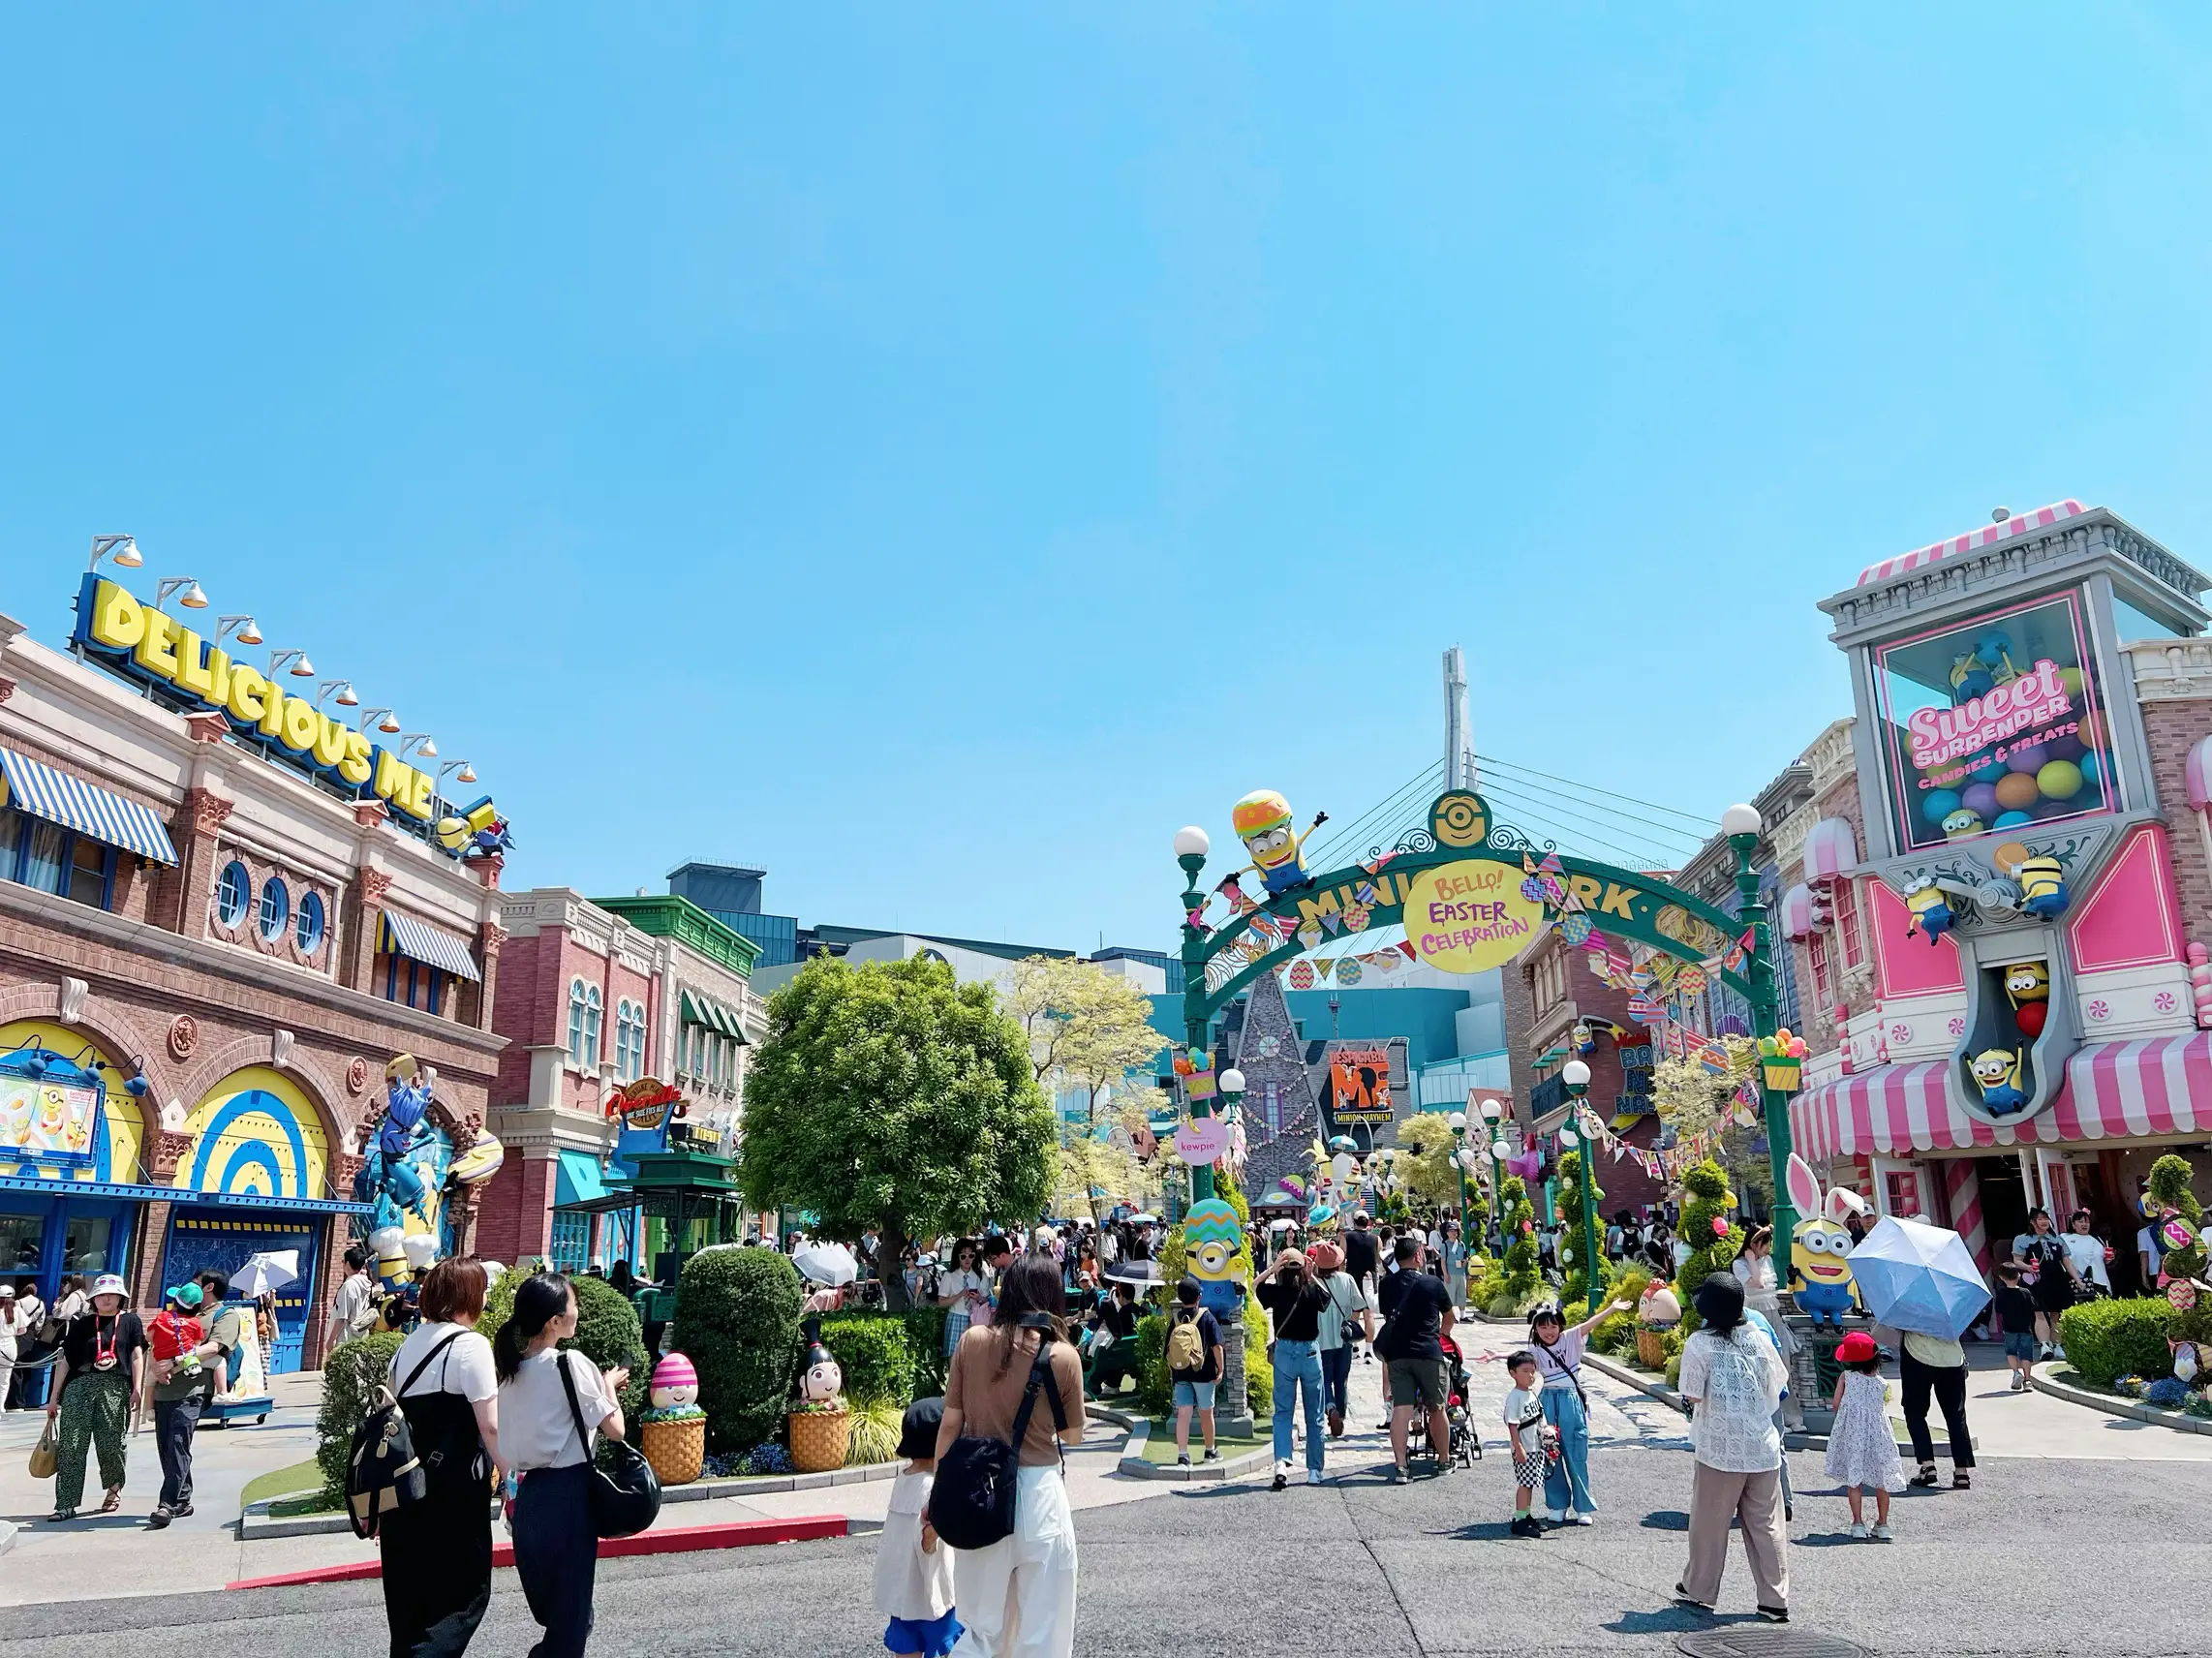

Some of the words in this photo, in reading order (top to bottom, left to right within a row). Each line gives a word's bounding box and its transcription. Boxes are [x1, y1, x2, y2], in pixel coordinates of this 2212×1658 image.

[91, 579, 372, 785] DELICIOUS
[374, 750, 434, 819] ME
[1910, 660, 2066, 751] Sweet
[1913, 695, 2072, 769] SURRENDER
[1918, 754, 1991, 789] CANDIES
[1995, 747, 2008, 763] &
[2011, 722, 2078, 754] TREATS
[1435, 870, 1504, 902] BELLO!
[1429, 902, 1509, 927] EASTER
[1421, 917, 1529, 956] CELEBRATION
[1330, 1050, 1388, 1063] DESPICABLE
[1331, 1062, 1393, 1109] ME
[1336, 1113, 1362, 1122] MINION
[1364, 1113, 1391, 1121] MAYHEM
[1181, 1141, 1215, 1152] kewpie
